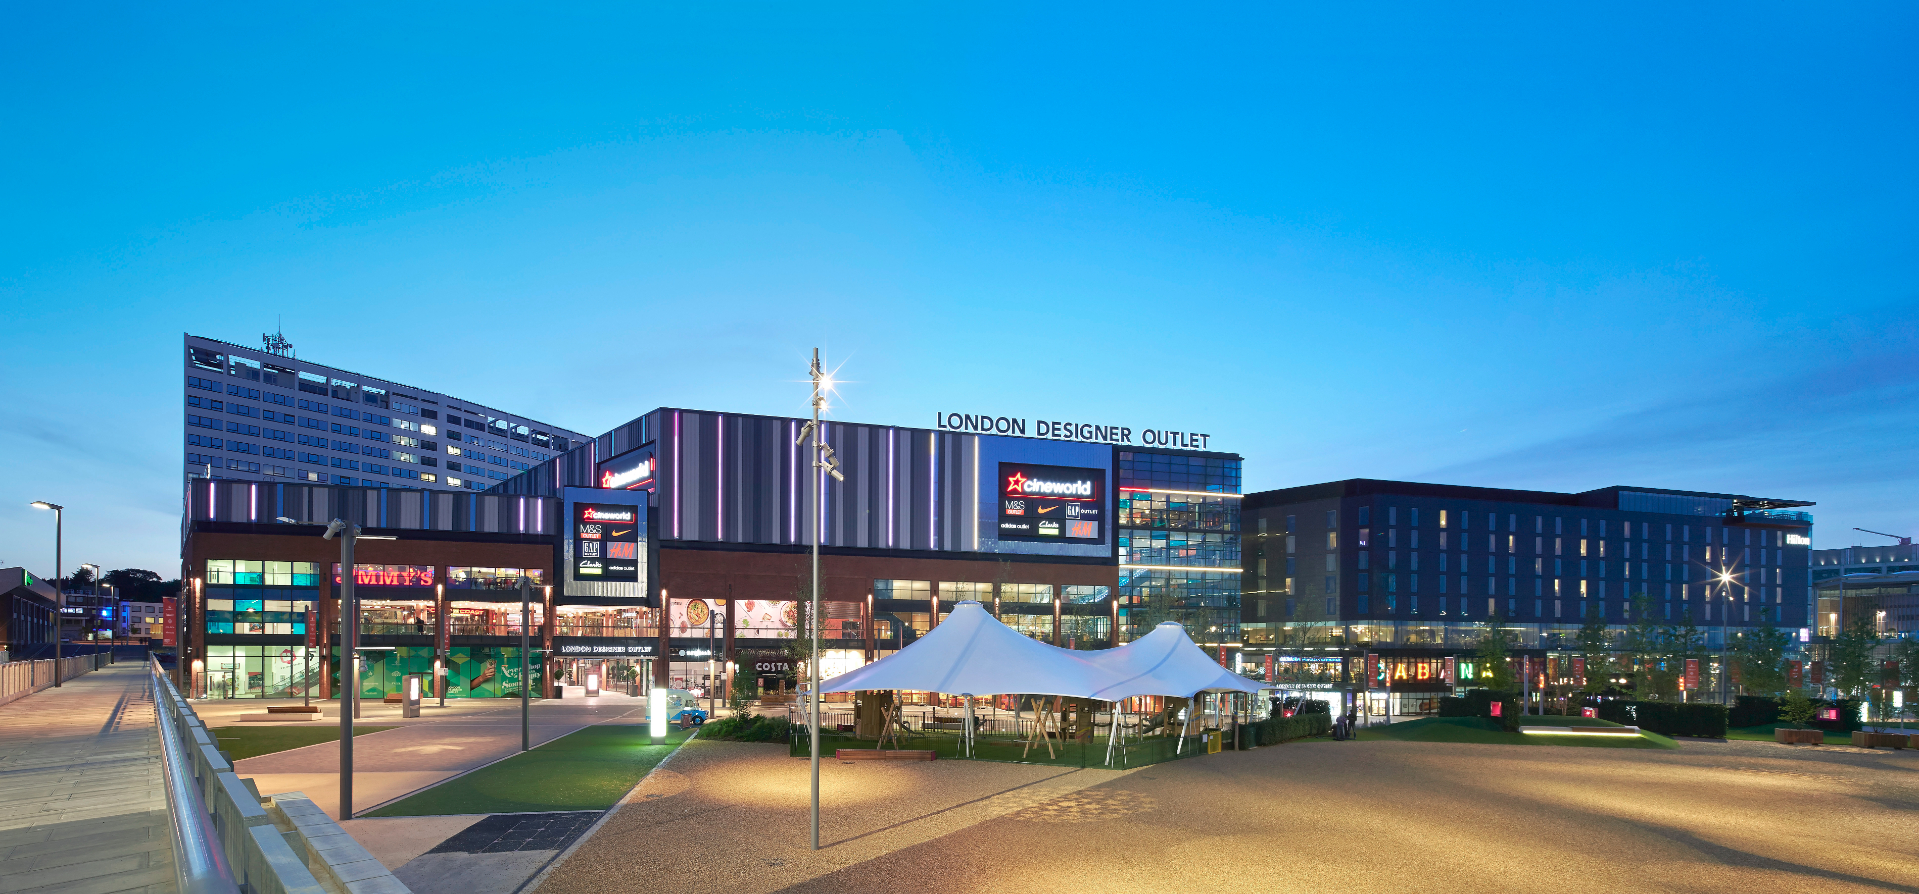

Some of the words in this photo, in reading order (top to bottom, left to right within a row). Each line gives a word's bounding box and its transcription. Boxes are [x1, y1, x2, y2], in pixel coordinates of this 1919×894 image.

[937, 411, 1026, 436] LONDON
[1036, 419, 1132, 444] DESIGNER
[1141, 428, 1211, 449] OUTLET
[1023, 478, 1091, 495] cineworld
[1005, 500, 1025, 510] M&S
[1067, 505, 1079, 516] GAP
[592, 511, 631, 520] cineworld
[580, 524, 602, 534] M&S
[1038, 520, 1059, 528] Clarks
[1072, 521, 1093, 537] H&M
[1786, 534, 1810, 545] Hilton
[584, 541, 598, 553] GAP
[609, 542, 635, 558] H&M
[580, 560, 602, 568] Clarks
[335, 569, 433, 586] JMMY'S
[756, 662, 789, 671] COSTA
